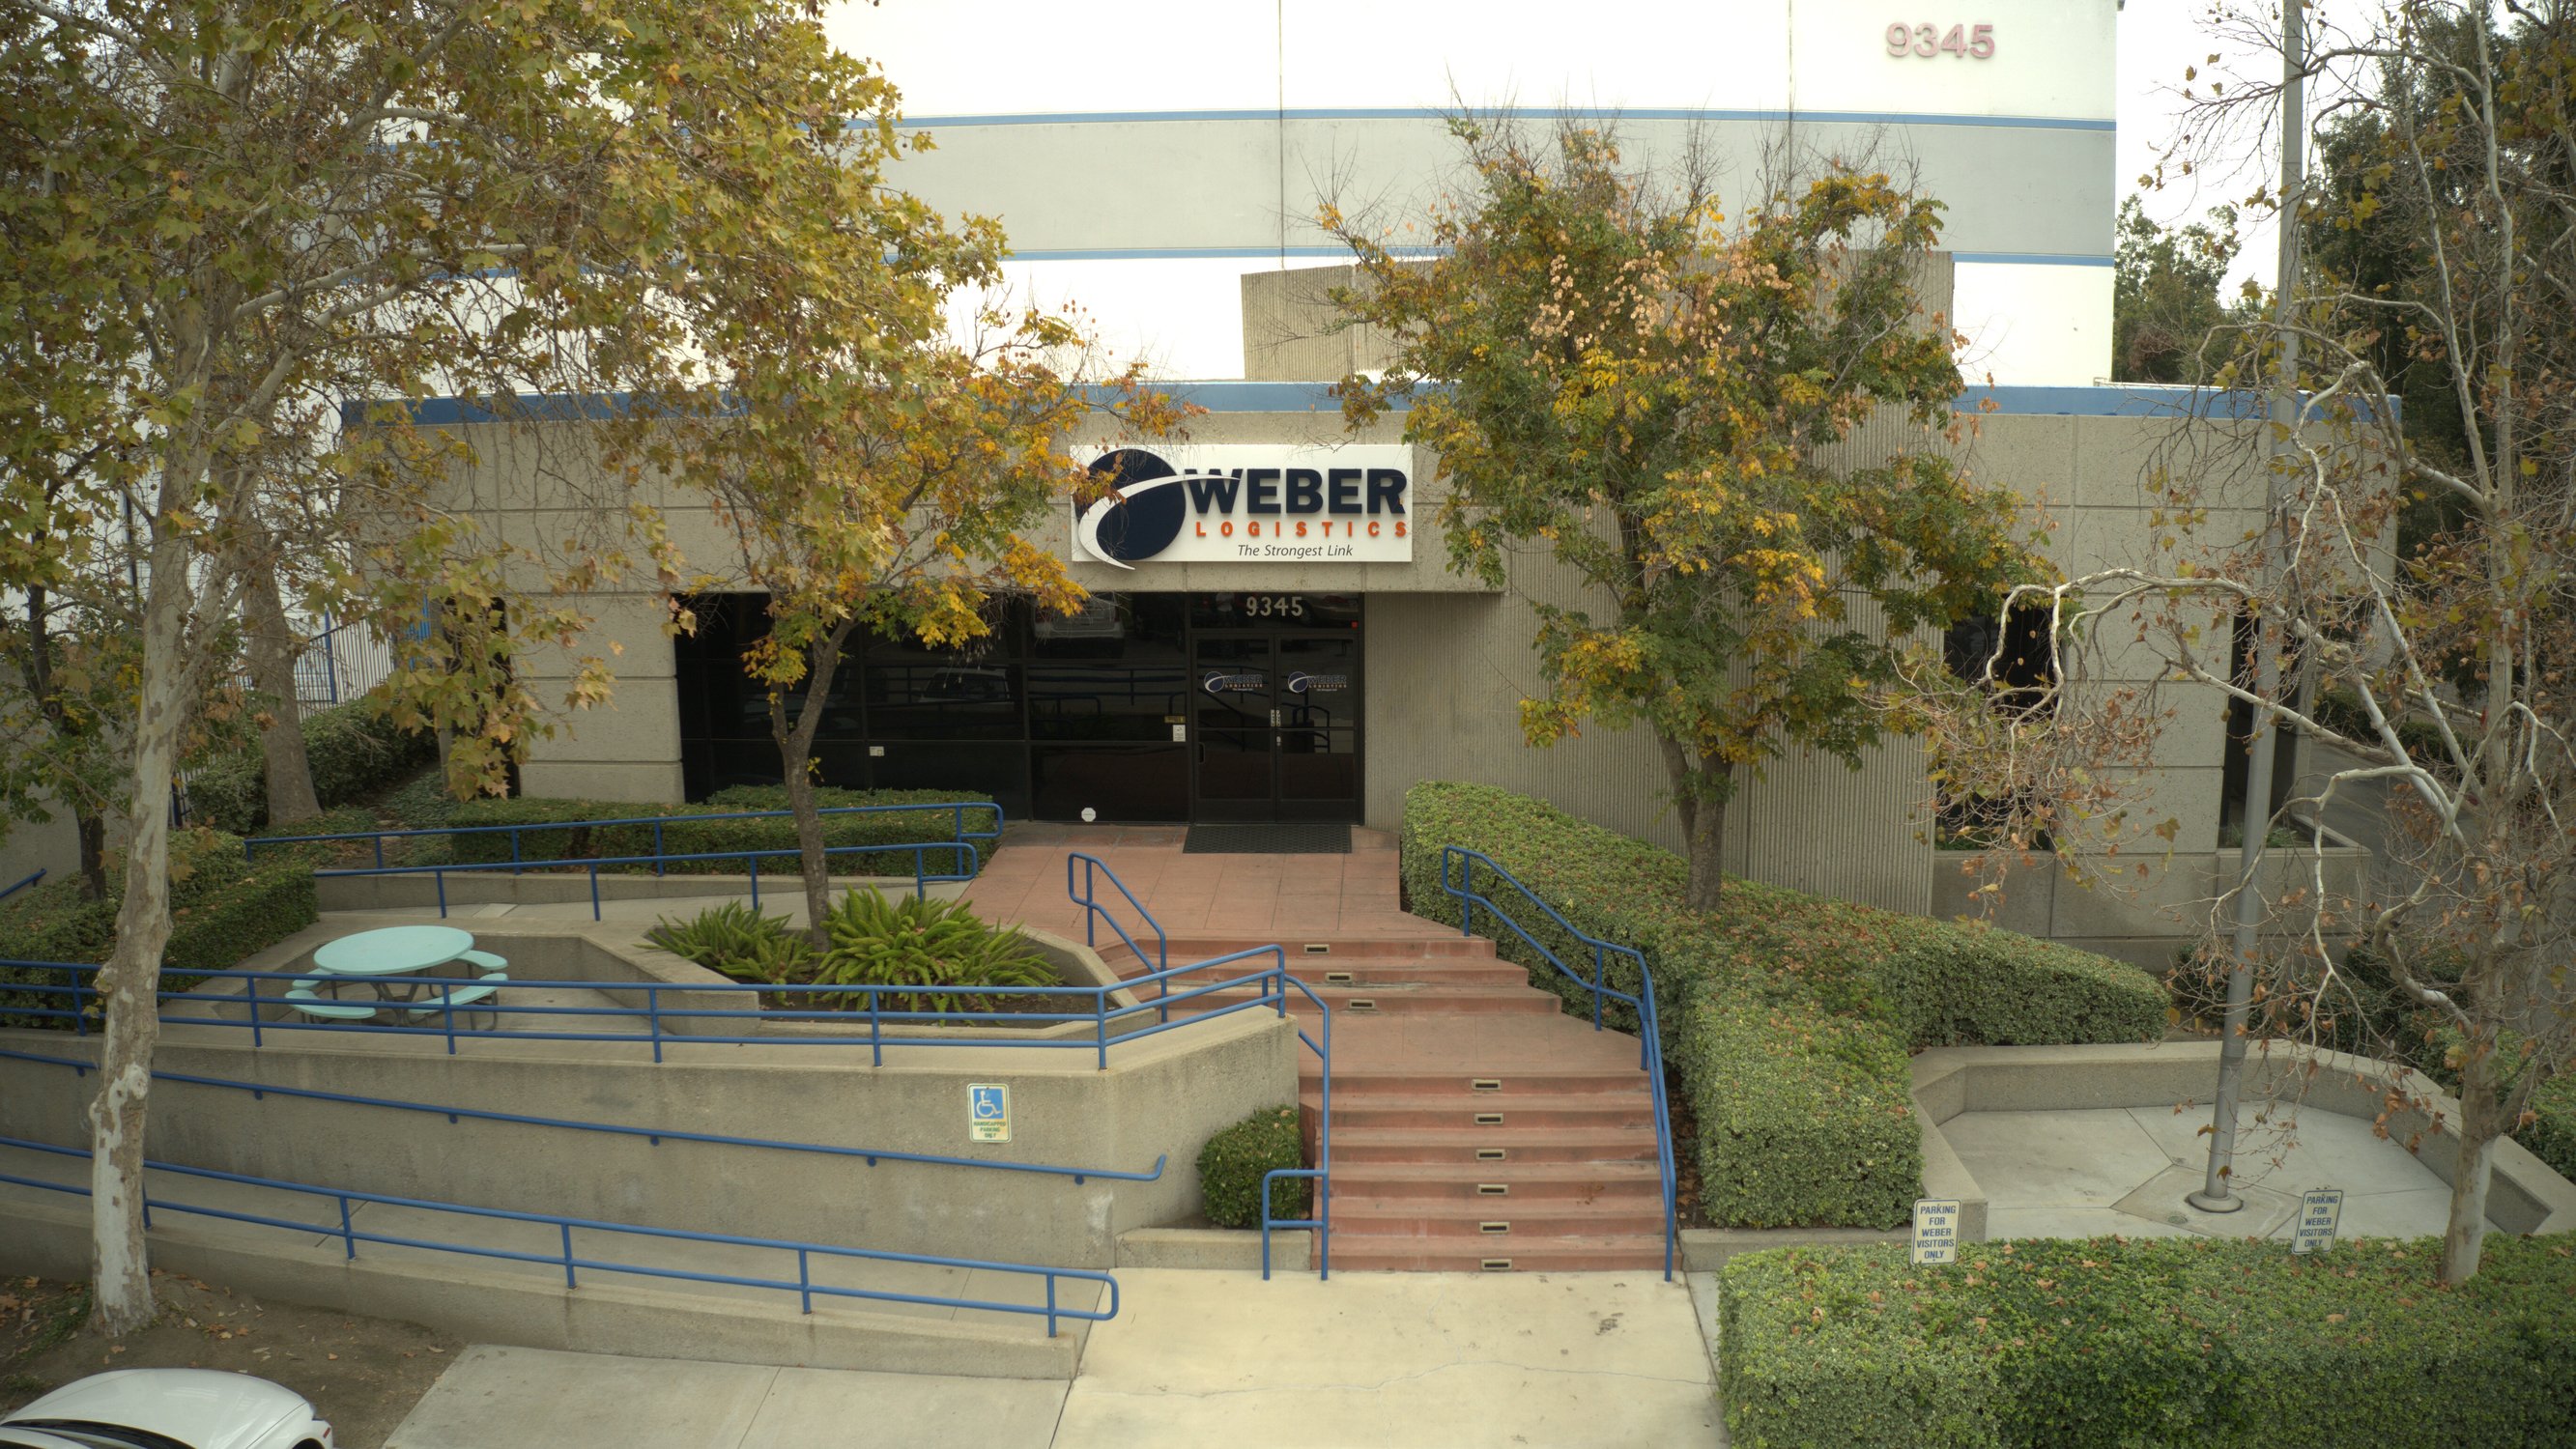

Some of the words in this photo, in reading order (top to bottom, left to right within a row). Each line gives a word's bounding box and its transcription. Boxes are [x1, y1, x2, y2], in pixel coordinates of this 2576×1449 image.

[1886, 22, 1995, 59] 9345
[1185, 469, 1407, 514] WEBER
[1196, 521, 1407, 537] LOGISTICS
[1238, 544, 1260, 556] The
[1264, 544, 1323, 559] Strongest
[1328, 544, 1353, 556] Link
[1246, 596, 1302, 616] 9345
[1920, 1206, 1956, 1214] PARKING
[1929, 1216, 1945, 1226] FOR
[2305, 1217, 2332, 1226] WEBER
[1922, 1228, 1951, 1236] WEBER
[2300, 1228, 2333, 1236] VISITORS
[1917, 1238, 1955, 1248] VISITORS
[2304, 1238, 2323, 1247] ONLY
[1924, 1250, 1944, 1259] ONLY
